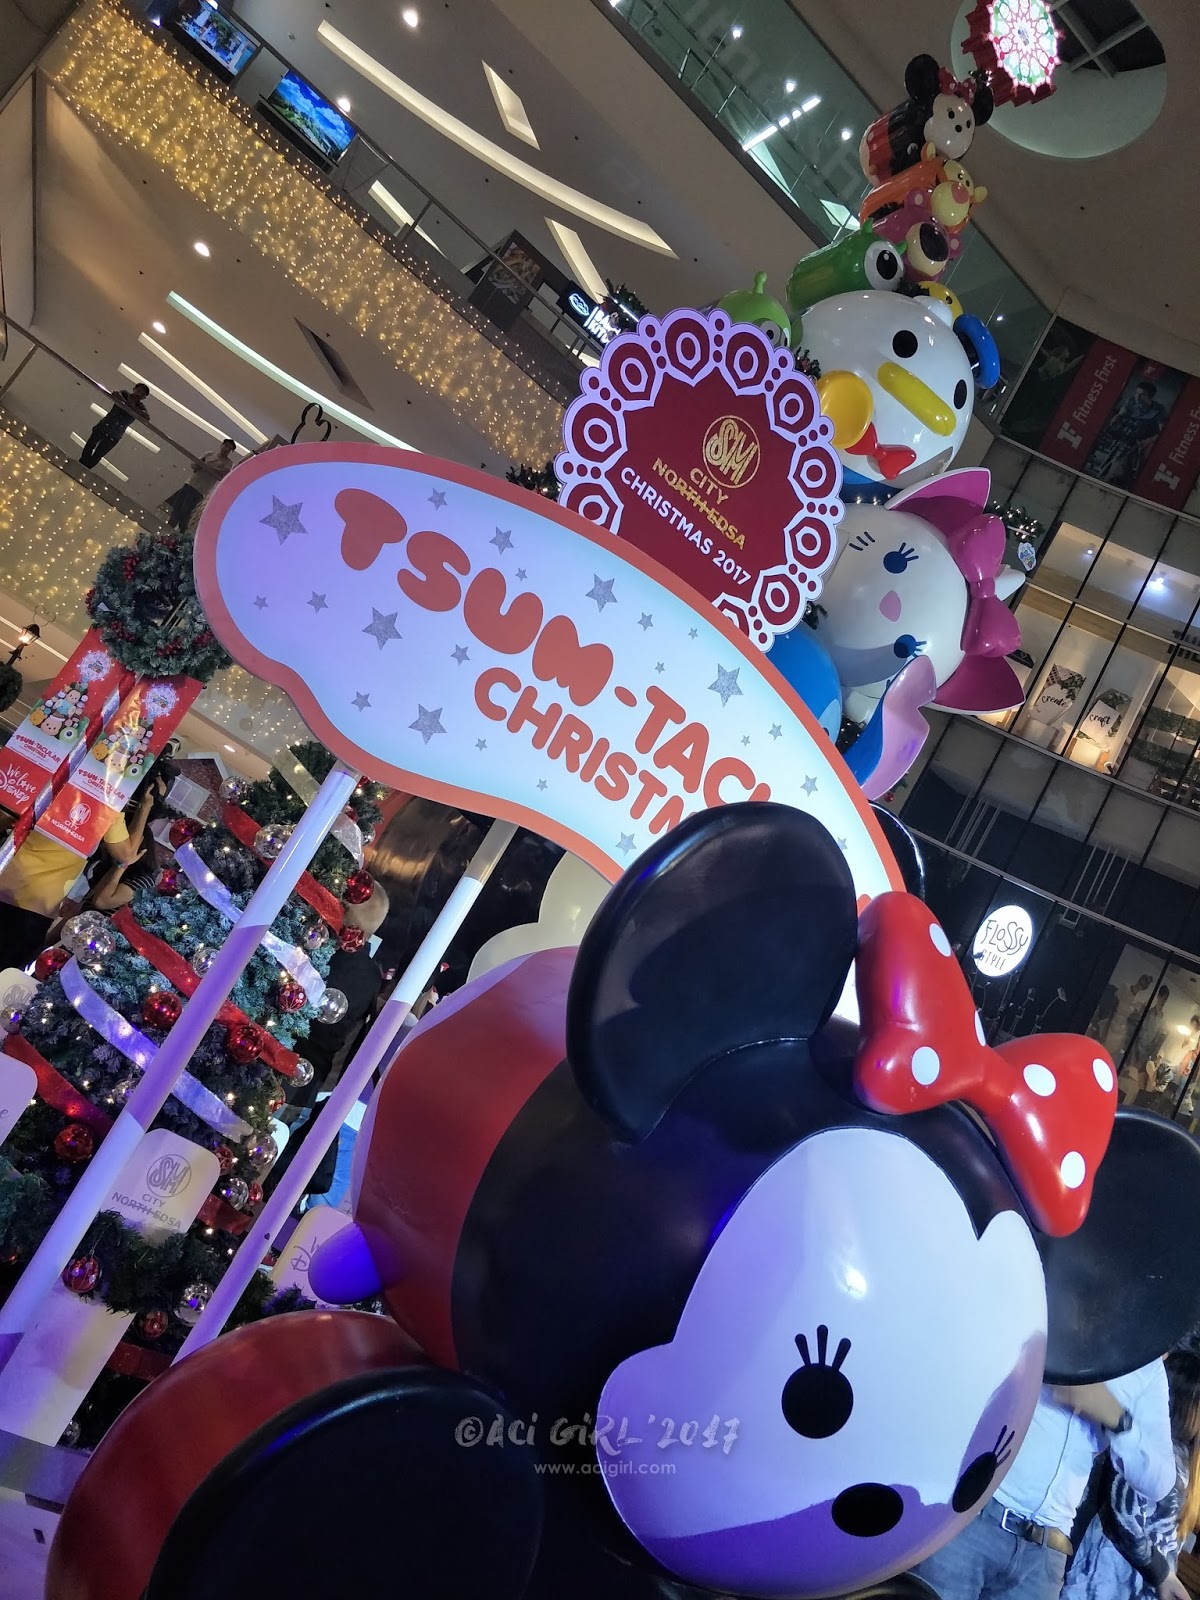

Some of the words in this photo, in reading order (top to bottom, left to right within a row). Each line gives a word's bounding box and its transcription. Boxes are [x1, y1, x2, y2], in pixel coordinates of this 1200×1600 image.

[689, 467, 729, 505] CITY
[620, 467, 713, 555] CHRISTMAS
[712, 550, 751, 585] 2017
[1041, 695, 1068, 708] create
[1089, 713, 1111, 727] craft
[64, 820, 79, 831] CITY
[980, 949, 1007, 970] STYLE
[142, 1193, 167, 1207] CITY
